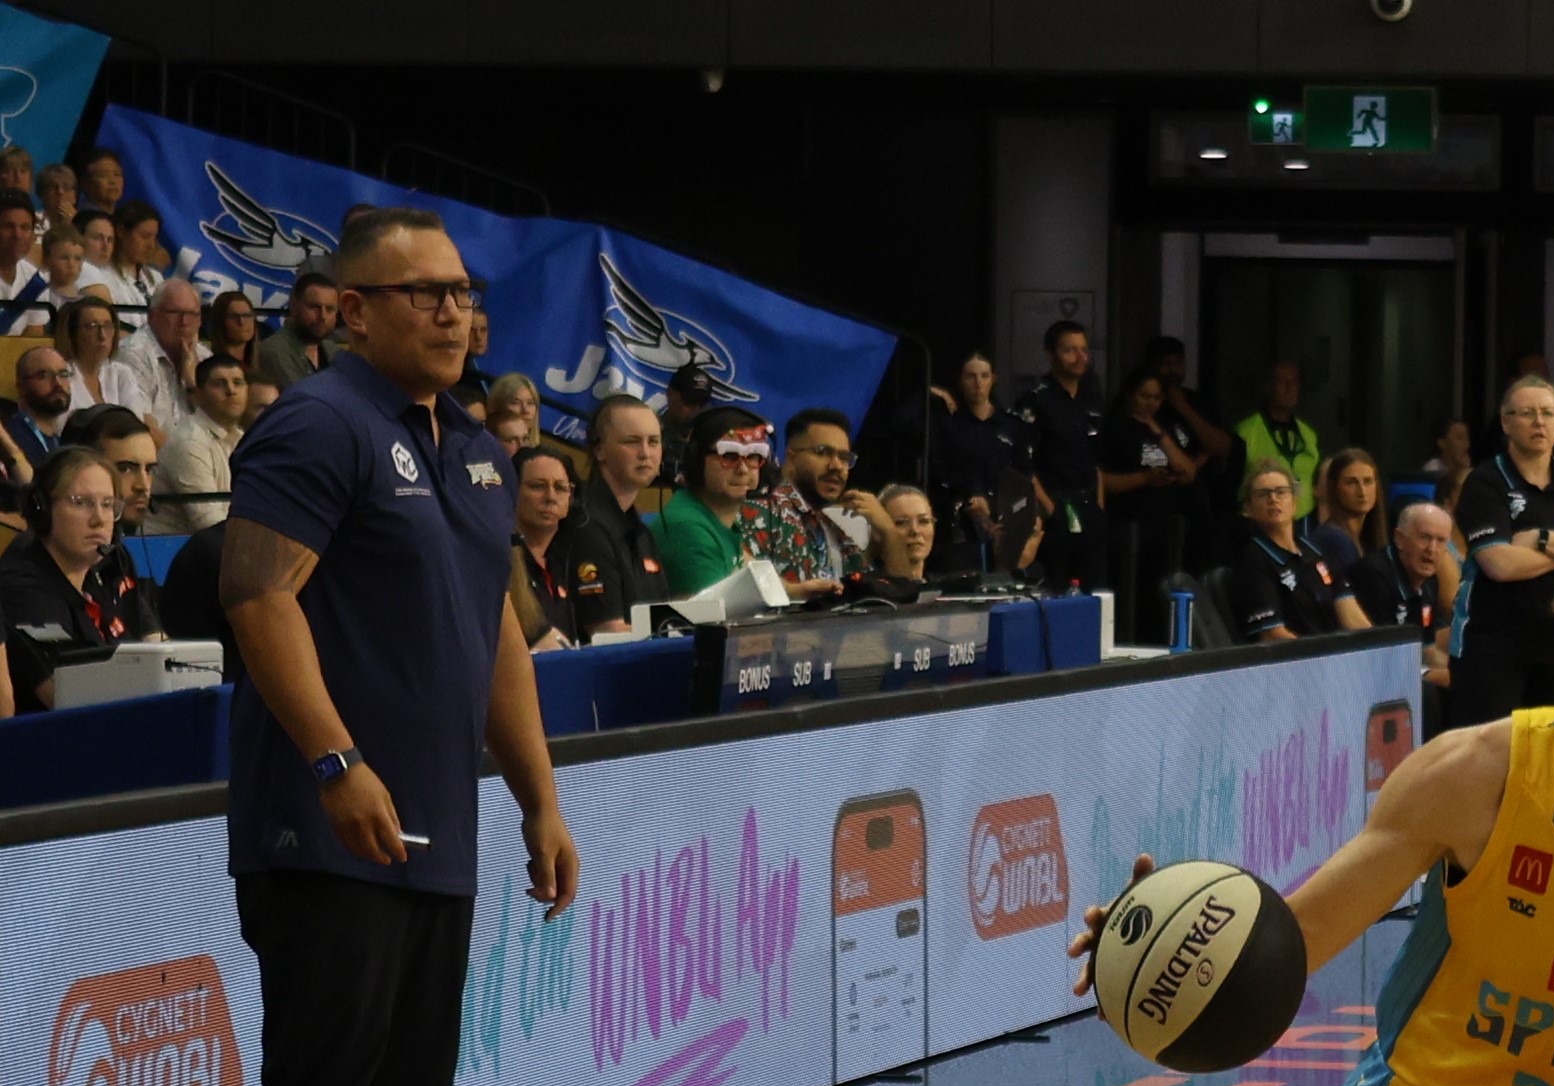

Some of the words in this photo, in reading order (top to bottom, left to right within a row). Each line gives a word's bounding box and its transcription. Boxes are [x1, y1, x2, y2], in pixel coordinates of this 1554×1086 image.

[792, 661, 812, 687] SUB
[913, 646, 931, 672] SUB
[948, 640, 975, 667] BONUS
[738, 664, 771, 694] BONUS
[1002, 851, 1066, 915] WNBL
[587, 835, 722, 1074] WNBL
[1137, 895, 1236, 1025] SPALDING
[115, 985, 212, 1045] CYGNETT
